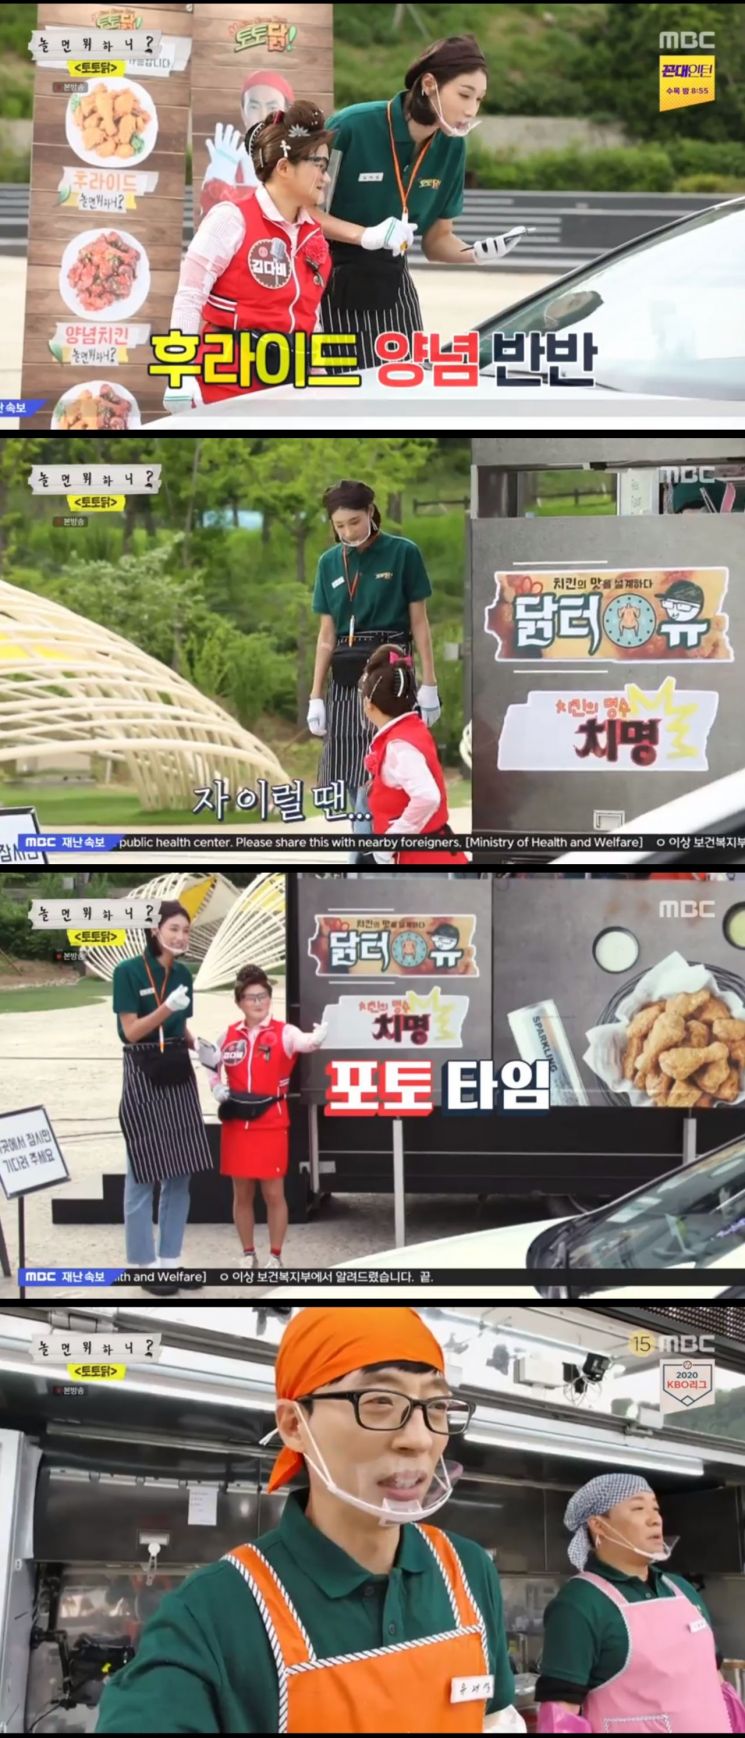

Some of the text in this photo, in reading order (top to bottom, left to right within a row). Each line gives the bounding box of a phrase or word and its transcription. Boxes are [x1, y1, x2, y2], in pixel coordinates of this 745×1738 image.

[74, 171, 137, 192] 후라이드
[251, 258, 287, 277] 김다비
[66, 326, 129, 346] 양념치킨
[553, 577, 587, 590] 치킨의
[556, 698, 599, 717] 치킨의
[573, 716, 662, 766] 치명
[371, 1013, 431, 1045] 치명
[533, 1016, 558, 1072] SPARKLING
